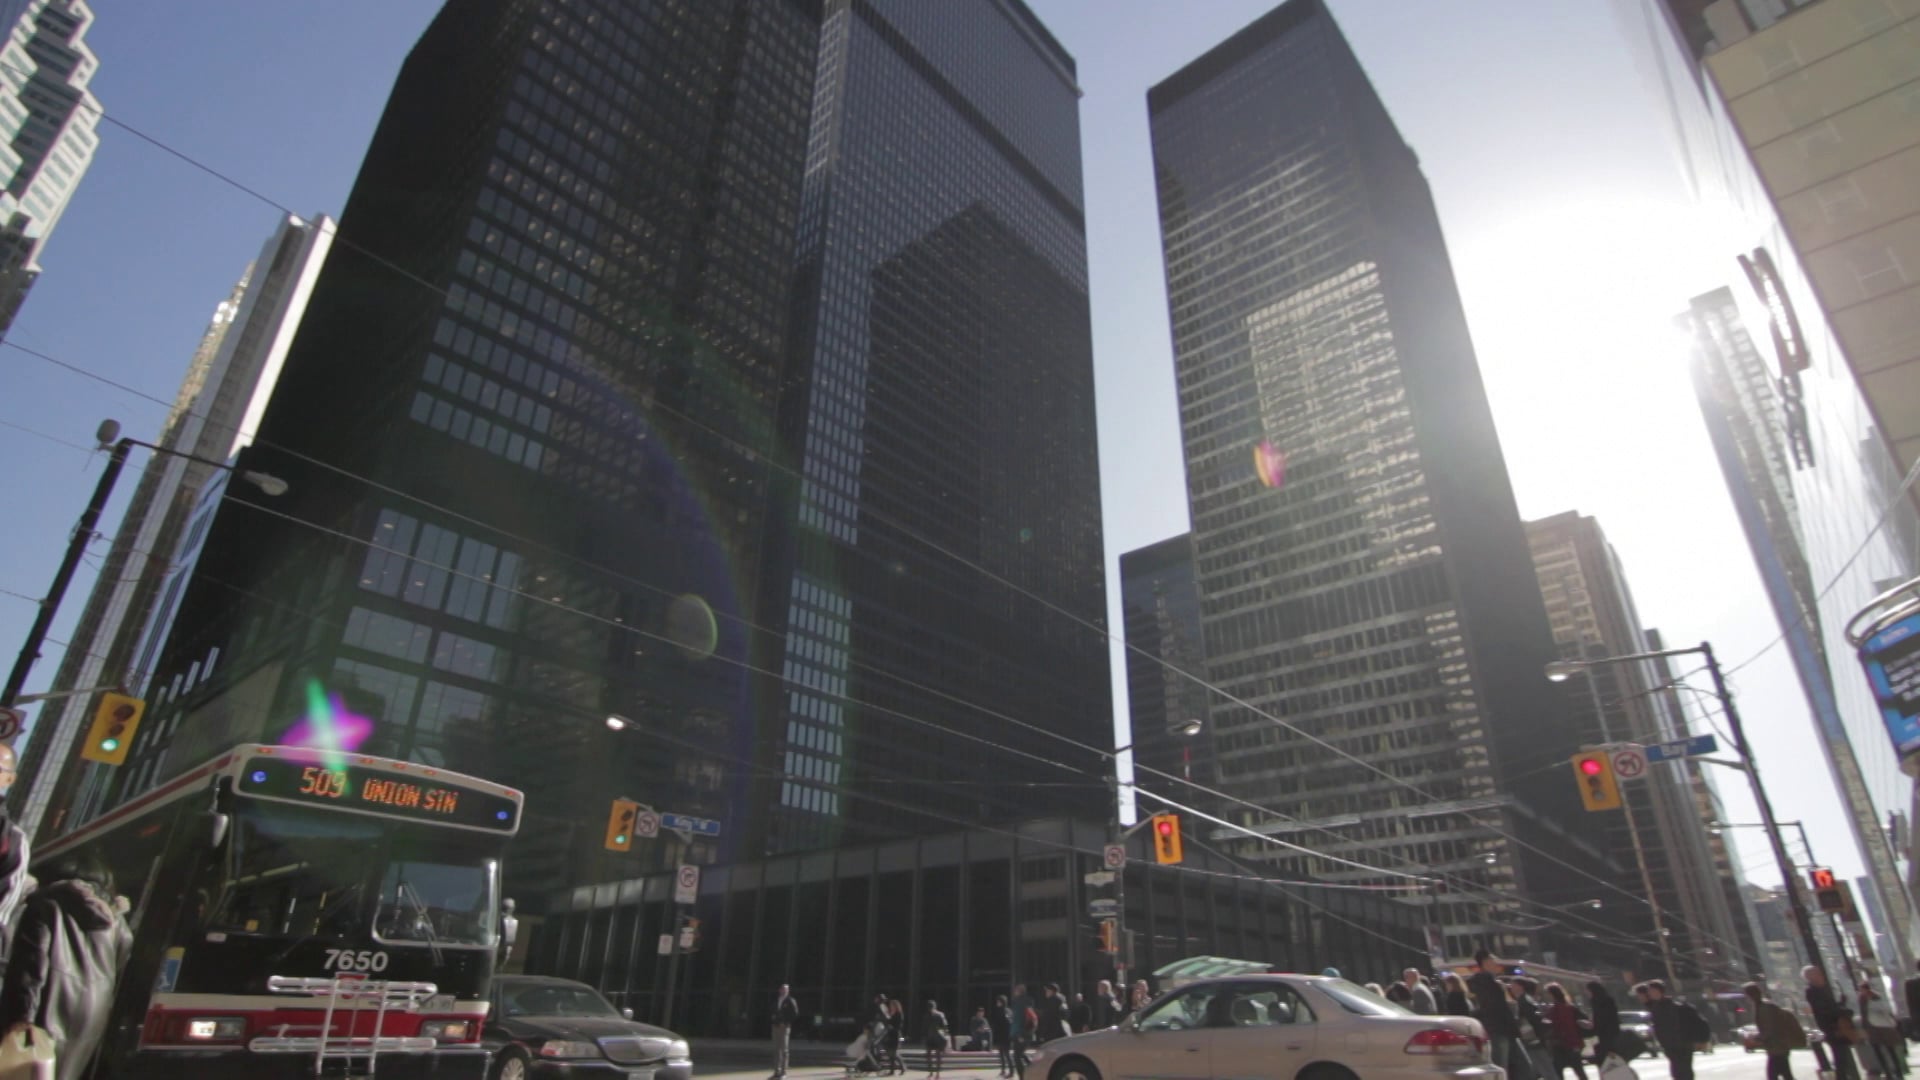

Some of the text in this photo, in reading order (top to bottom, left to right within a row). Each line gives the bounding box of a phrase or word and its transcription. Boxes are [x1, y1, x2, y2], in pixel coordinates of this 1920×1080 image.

[300, 767, 459, 814] 509 UNION STN
[323, 949, 389, 973] 7650
